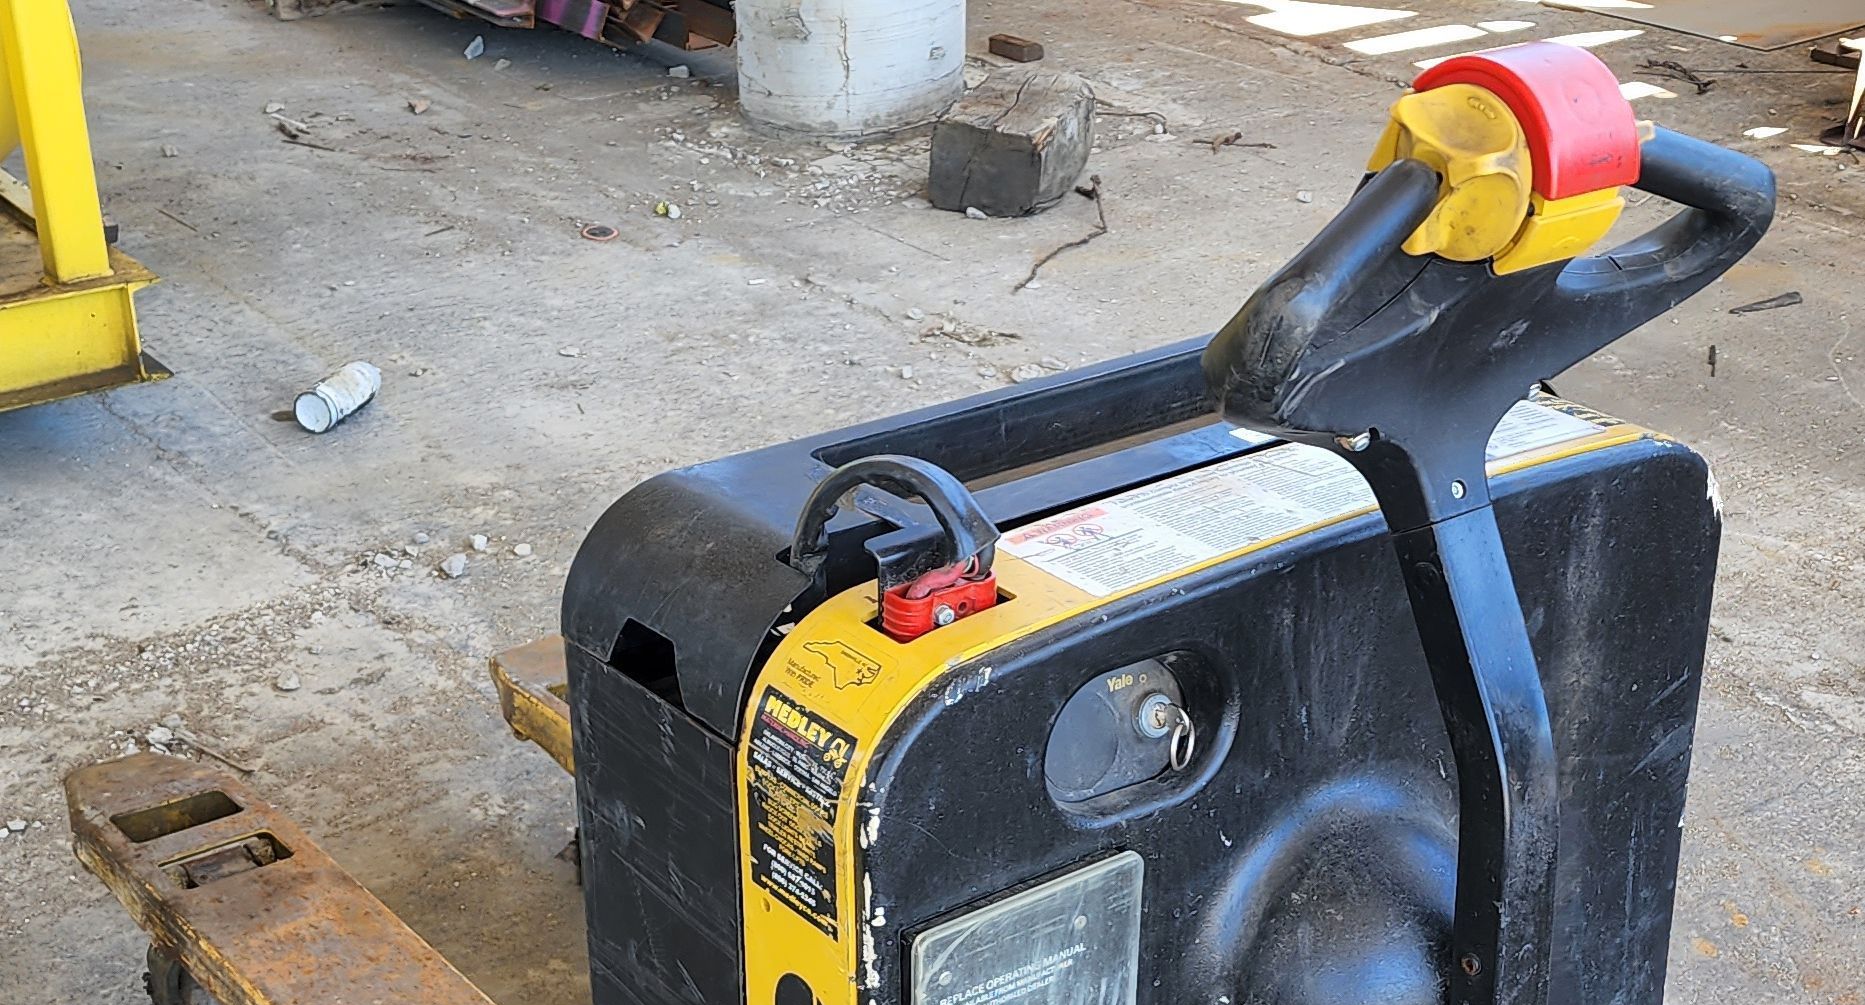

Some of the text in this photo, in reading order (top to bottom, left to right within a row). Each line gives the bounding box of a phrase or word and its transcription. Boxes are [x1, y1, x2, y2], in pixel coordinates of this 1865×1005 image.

[1106, 673, 1134, 693] Yale
[764, 694, 834, 748] MEDLEY
[1042, 942, 1088, 968] MANUAL
